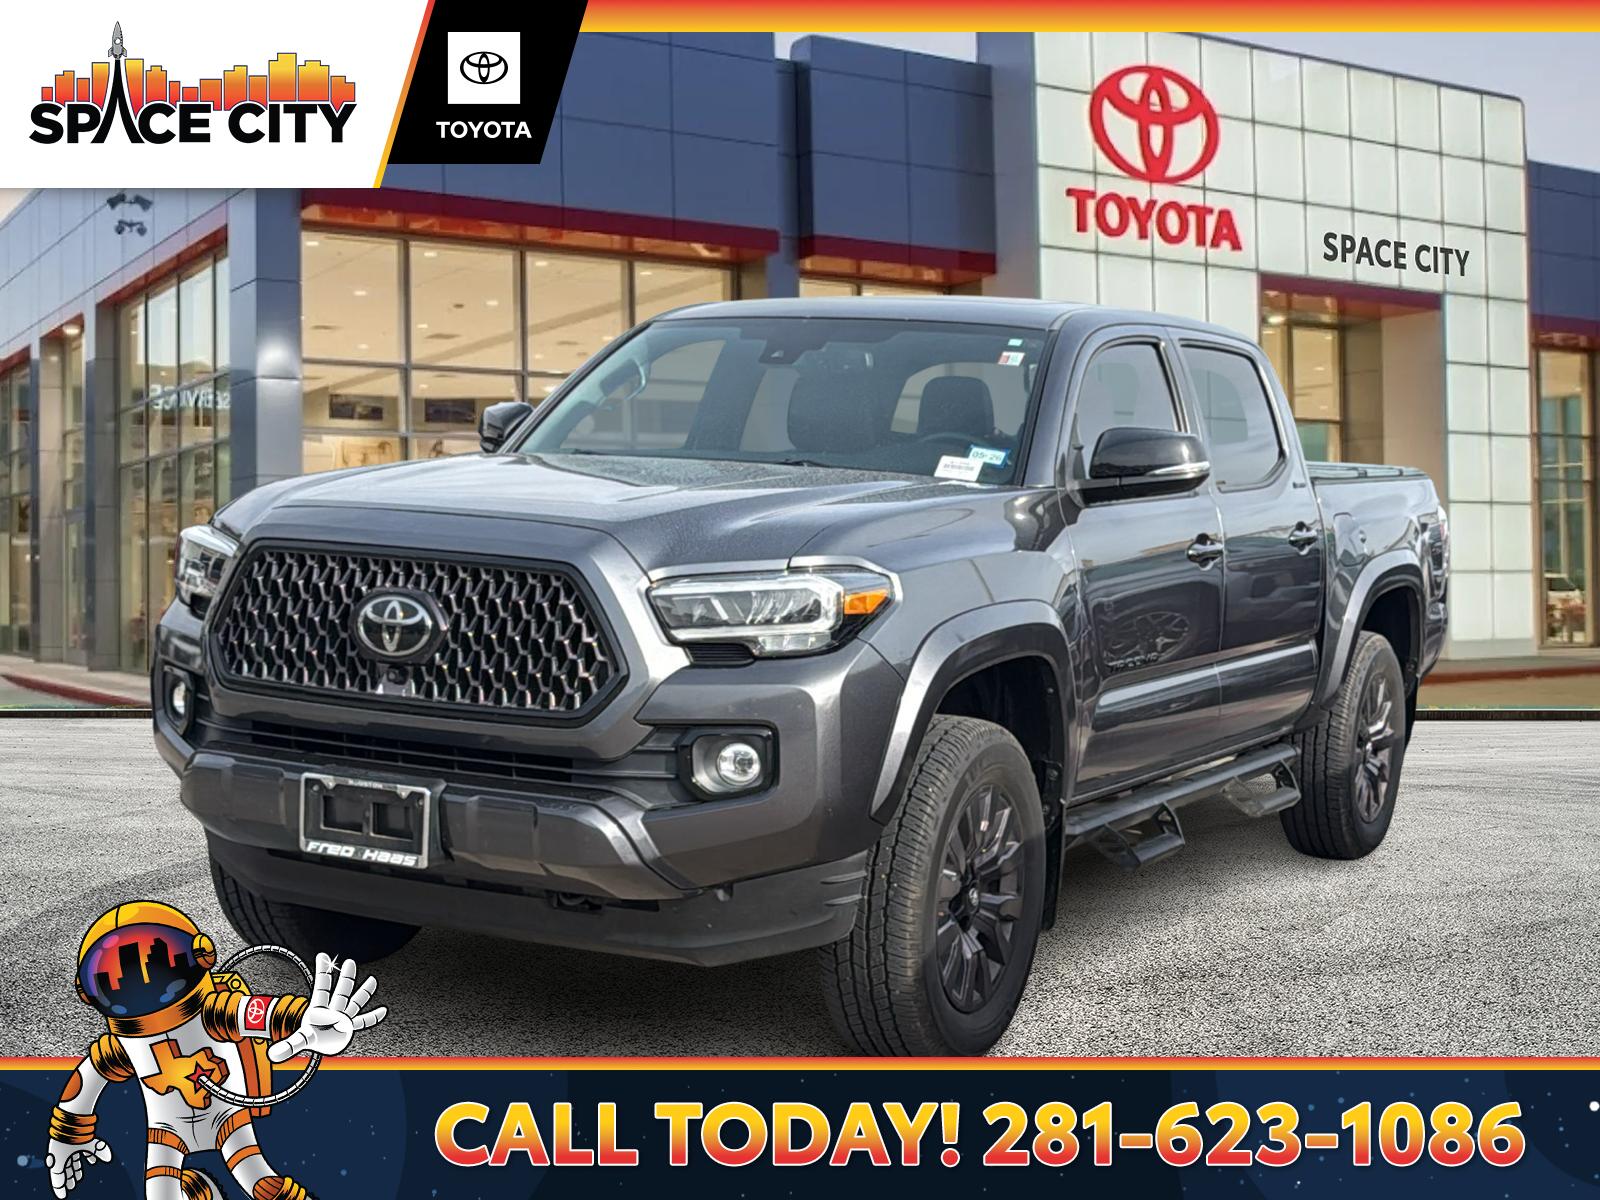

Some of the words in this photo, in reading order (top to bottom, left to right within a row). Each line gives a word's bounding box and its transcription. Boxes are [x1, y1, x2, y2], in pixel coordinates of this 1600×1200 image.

[1066, 188, 1242, 251] TOYOTA
[1323, 231, 1407, 270] SPACE
[1414, 244, 1470, 277] CITY
